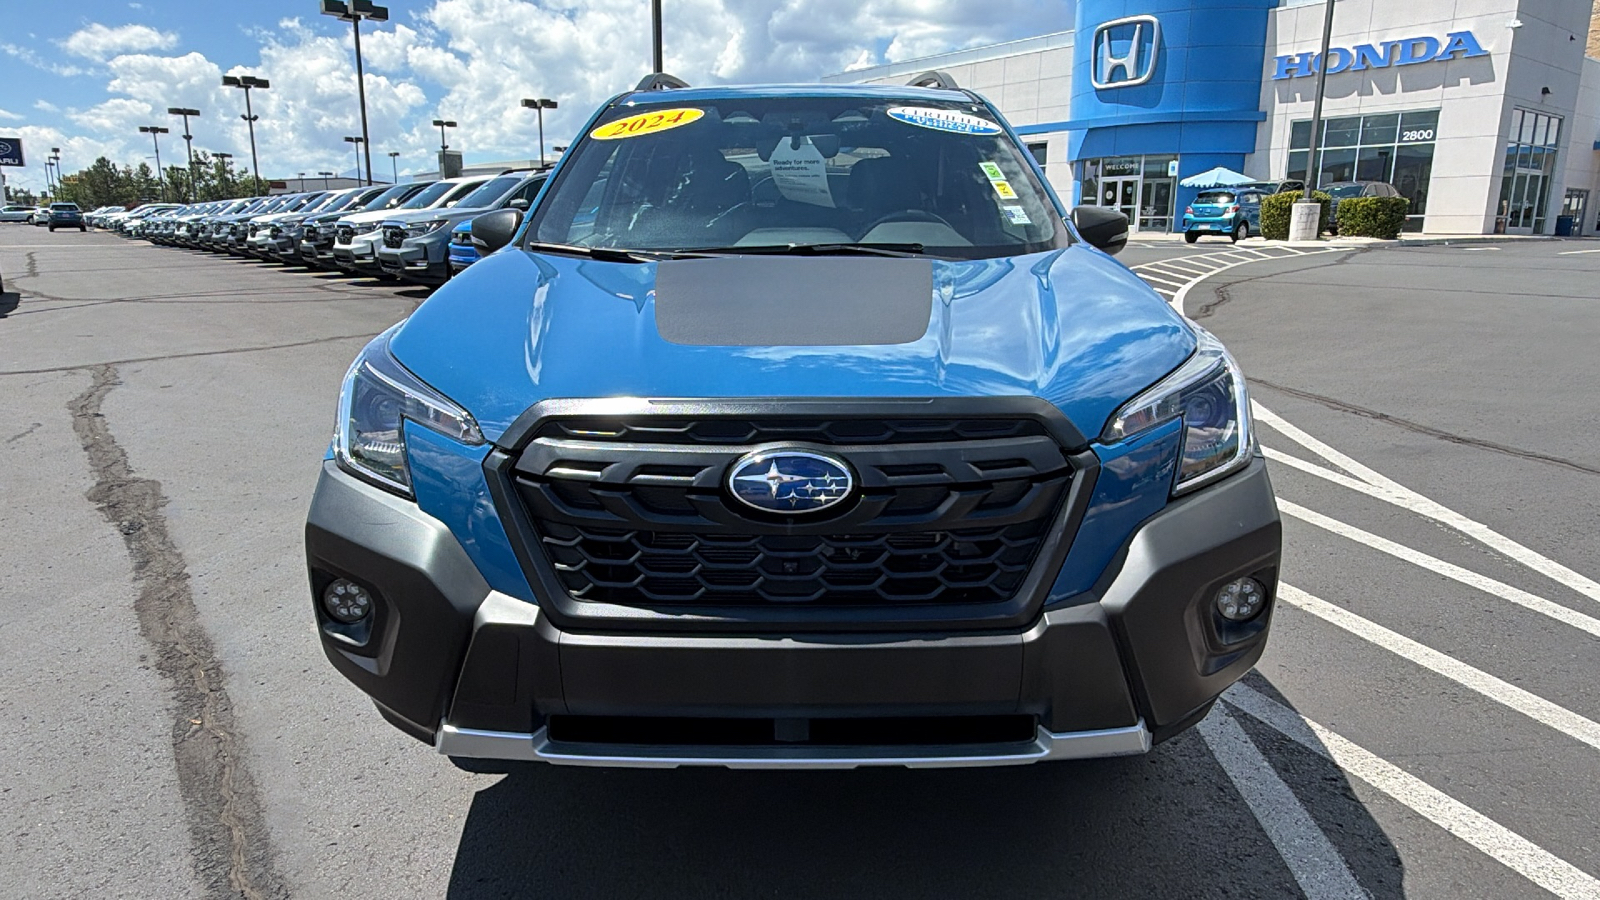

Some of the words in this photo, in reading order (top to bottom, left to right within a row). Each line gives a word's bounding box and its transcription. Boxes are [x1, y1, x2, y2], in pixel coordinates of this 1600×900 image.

[1271, 30, 1488, 80] HONDA
[608, 110, 686, 137] 2024
[1402, 129, 1434, 141] 2800
[1105, 162, 1139, 171] WELCOME
